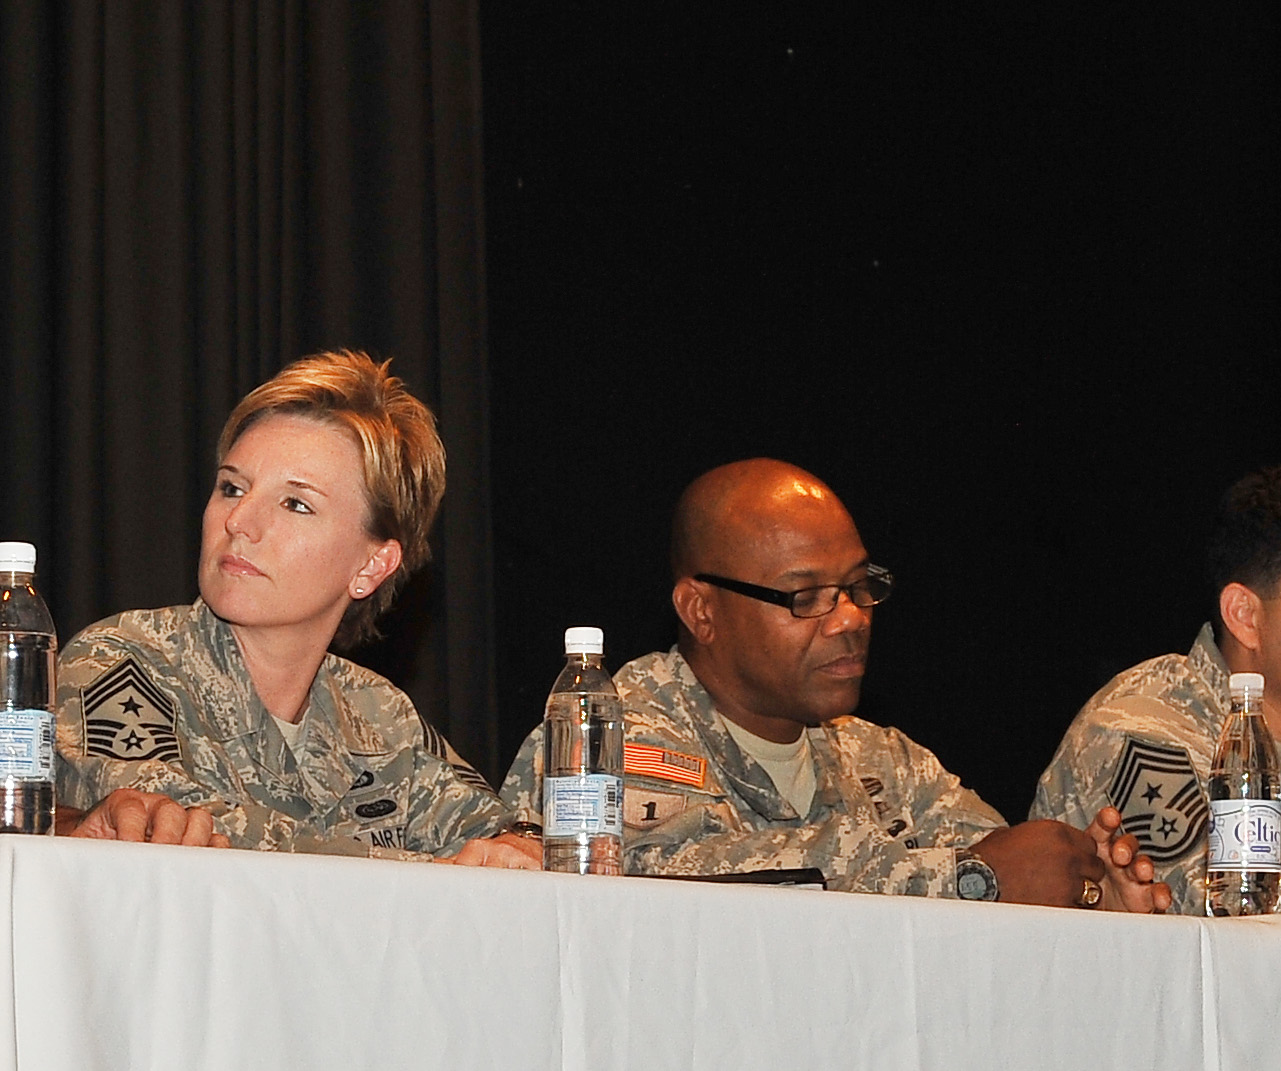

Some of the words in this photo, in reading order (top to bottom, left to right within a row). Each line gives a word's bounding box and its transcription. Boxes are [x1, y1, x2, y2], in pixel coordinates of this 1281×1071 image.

[640, 801, 660, 821] 1
[371, 829, 396, 849] AIR
[396, 826, 407, 849] F
